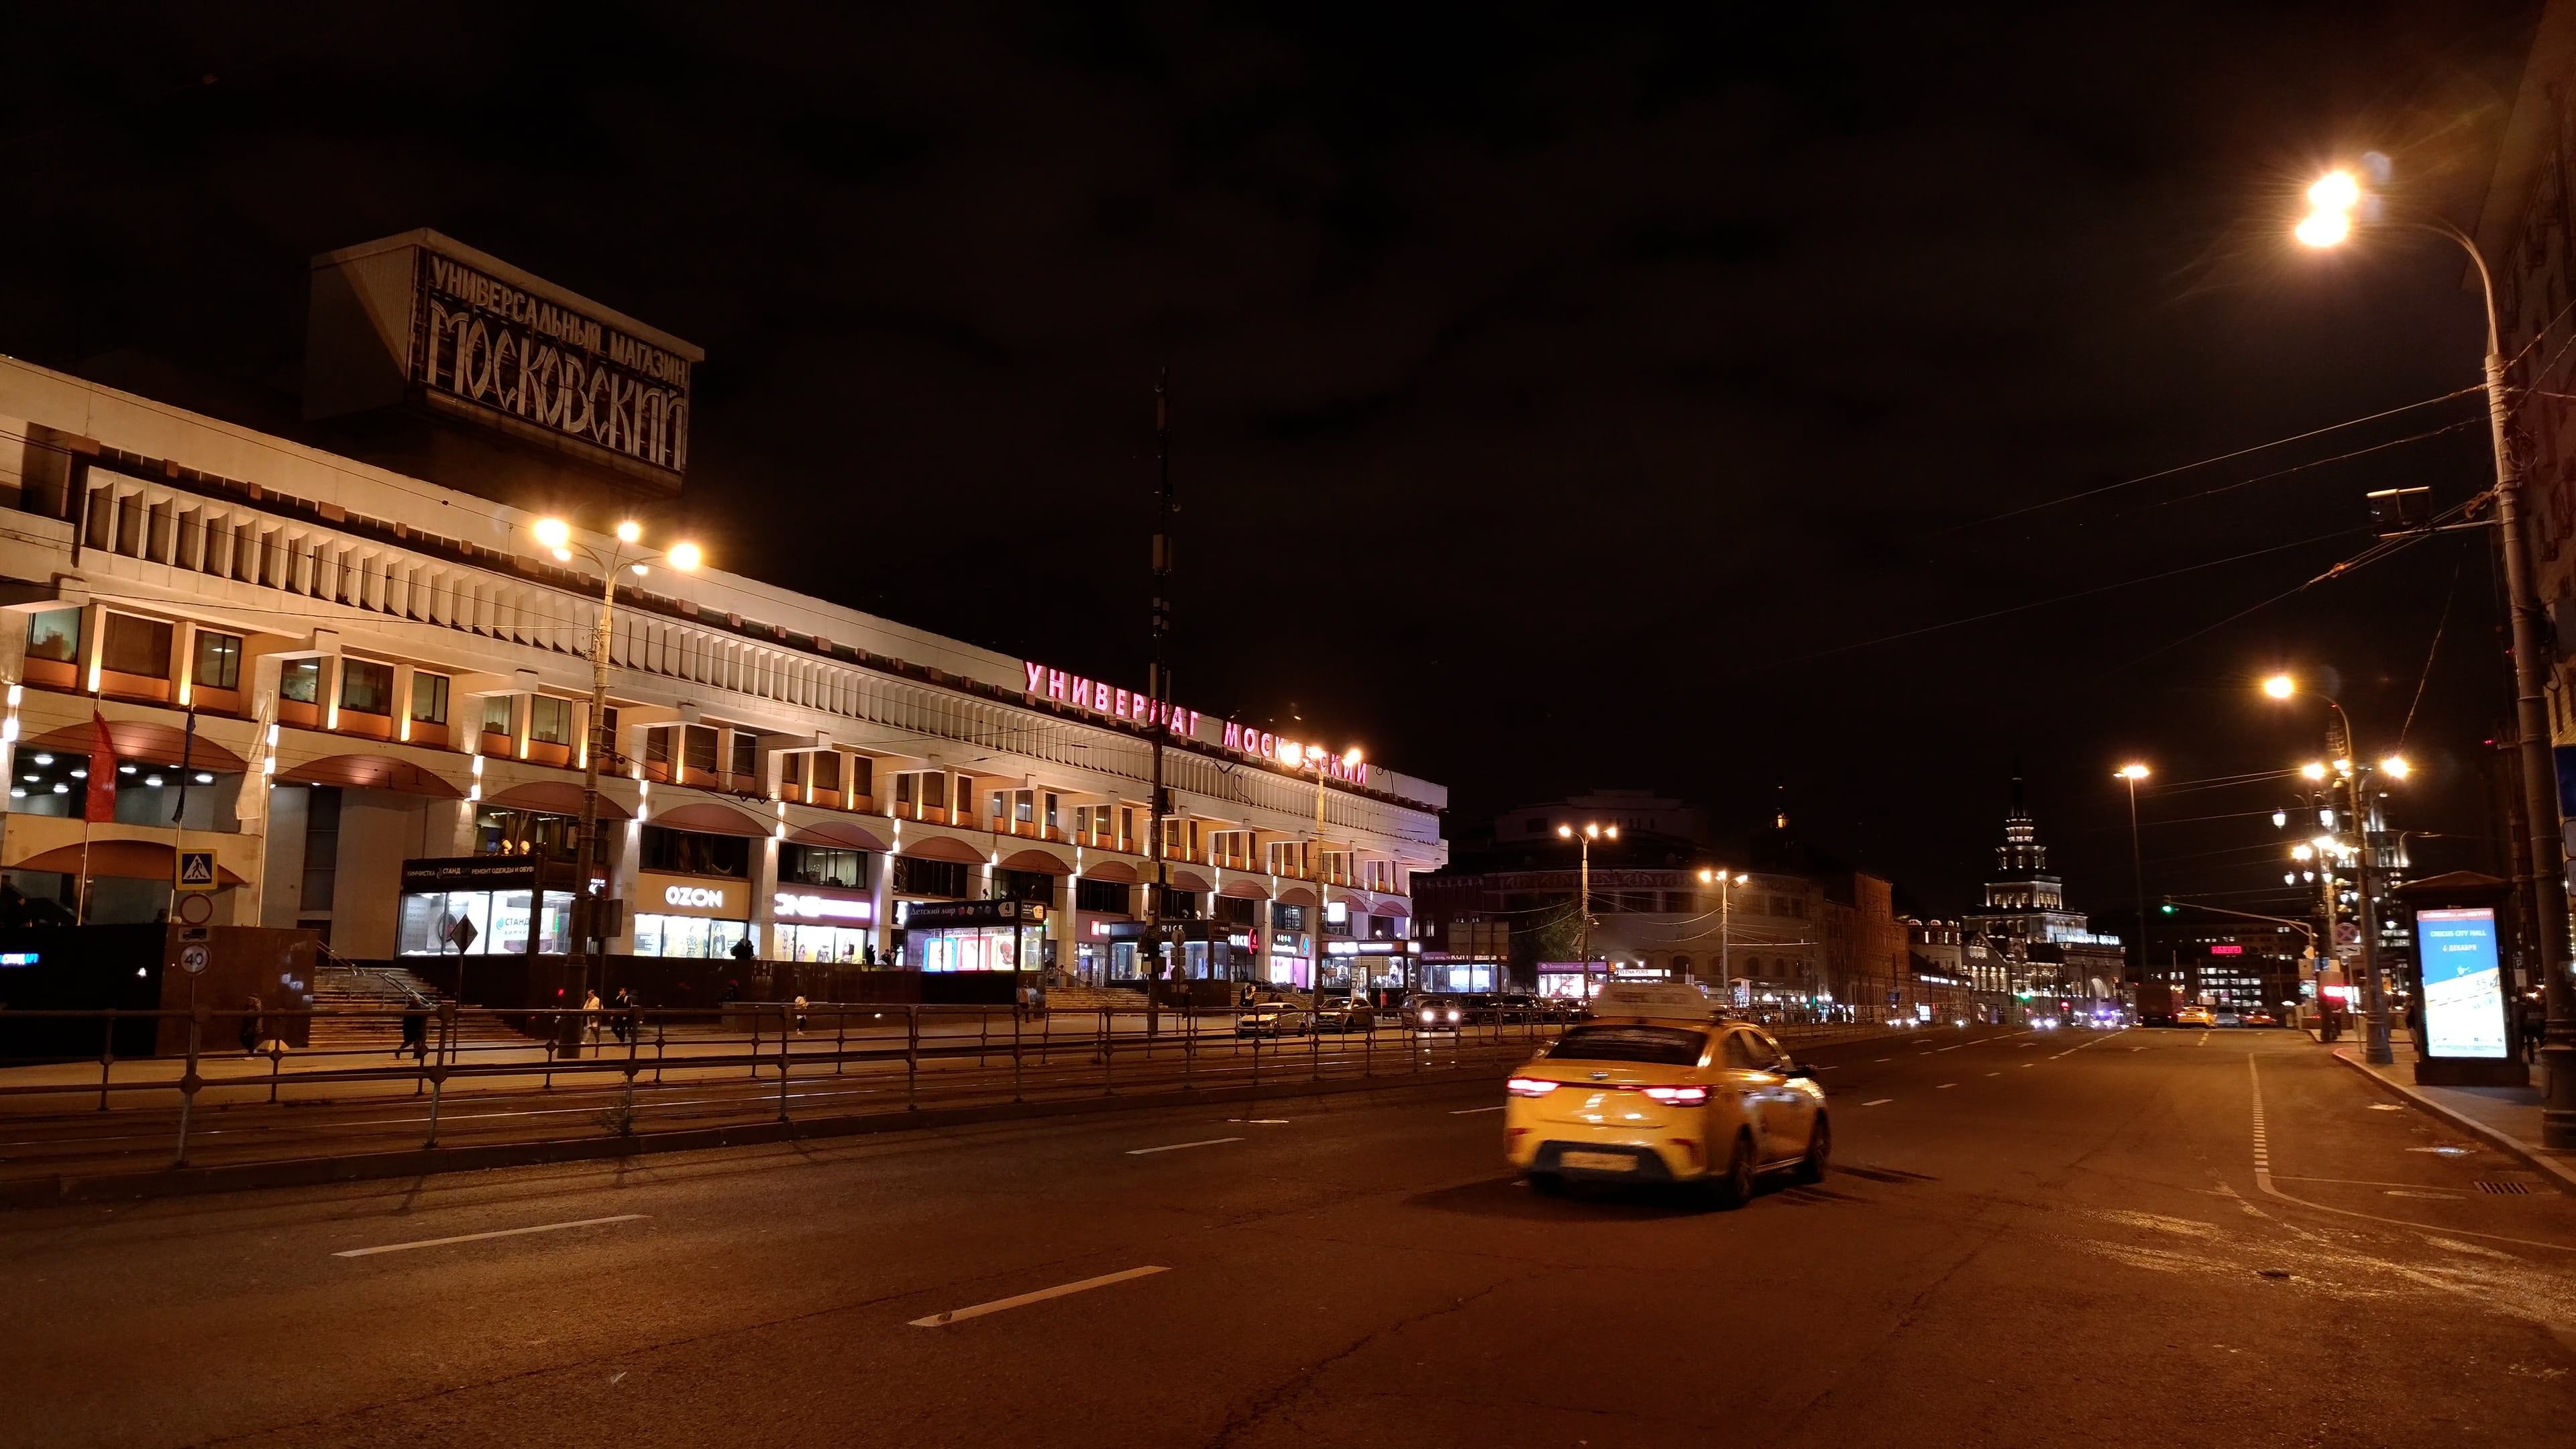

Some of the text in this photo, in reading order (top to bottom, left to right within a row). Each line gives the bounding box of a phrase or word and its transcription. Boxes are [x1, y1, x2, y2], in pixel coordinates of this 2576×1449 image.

[429, 256, 688, 383] УНИВЕРСАЛЬНЫЙ МАГАЗИН
[426, 298, 687, 472] МОСКОВСКИЙ
[665, 885, 722, 908] OZON
[910, 906, 956, 916] Детский мир
[1004, 903, 1010, 912] 4
[1252, 934, 1257, 945] 4
[184, 952, 203, 966] 40
